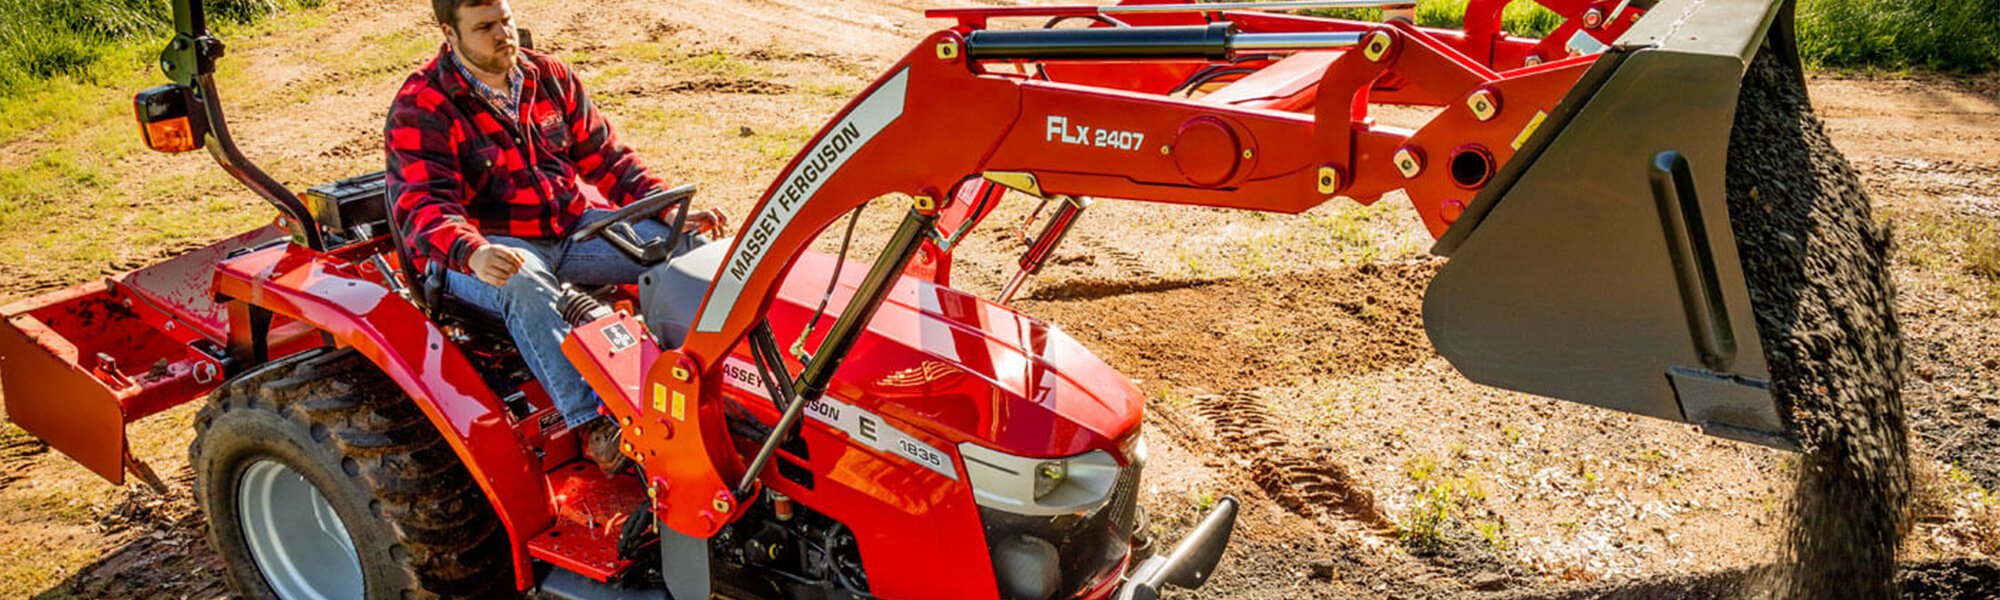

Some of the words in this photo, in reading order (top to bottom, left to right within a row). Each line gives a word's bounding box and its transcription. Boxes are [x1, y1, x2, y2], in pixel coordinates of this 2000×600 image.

[1094, 129, 1144, 151] 2407
[730, 207, 781, 281] MASSEY
[778, 121, 861, 212] FERGUSON
[723, 363, 762, 388] ASSEY
[858, 415, 877, 441] E
[899, 440, 941, 466] 1835
